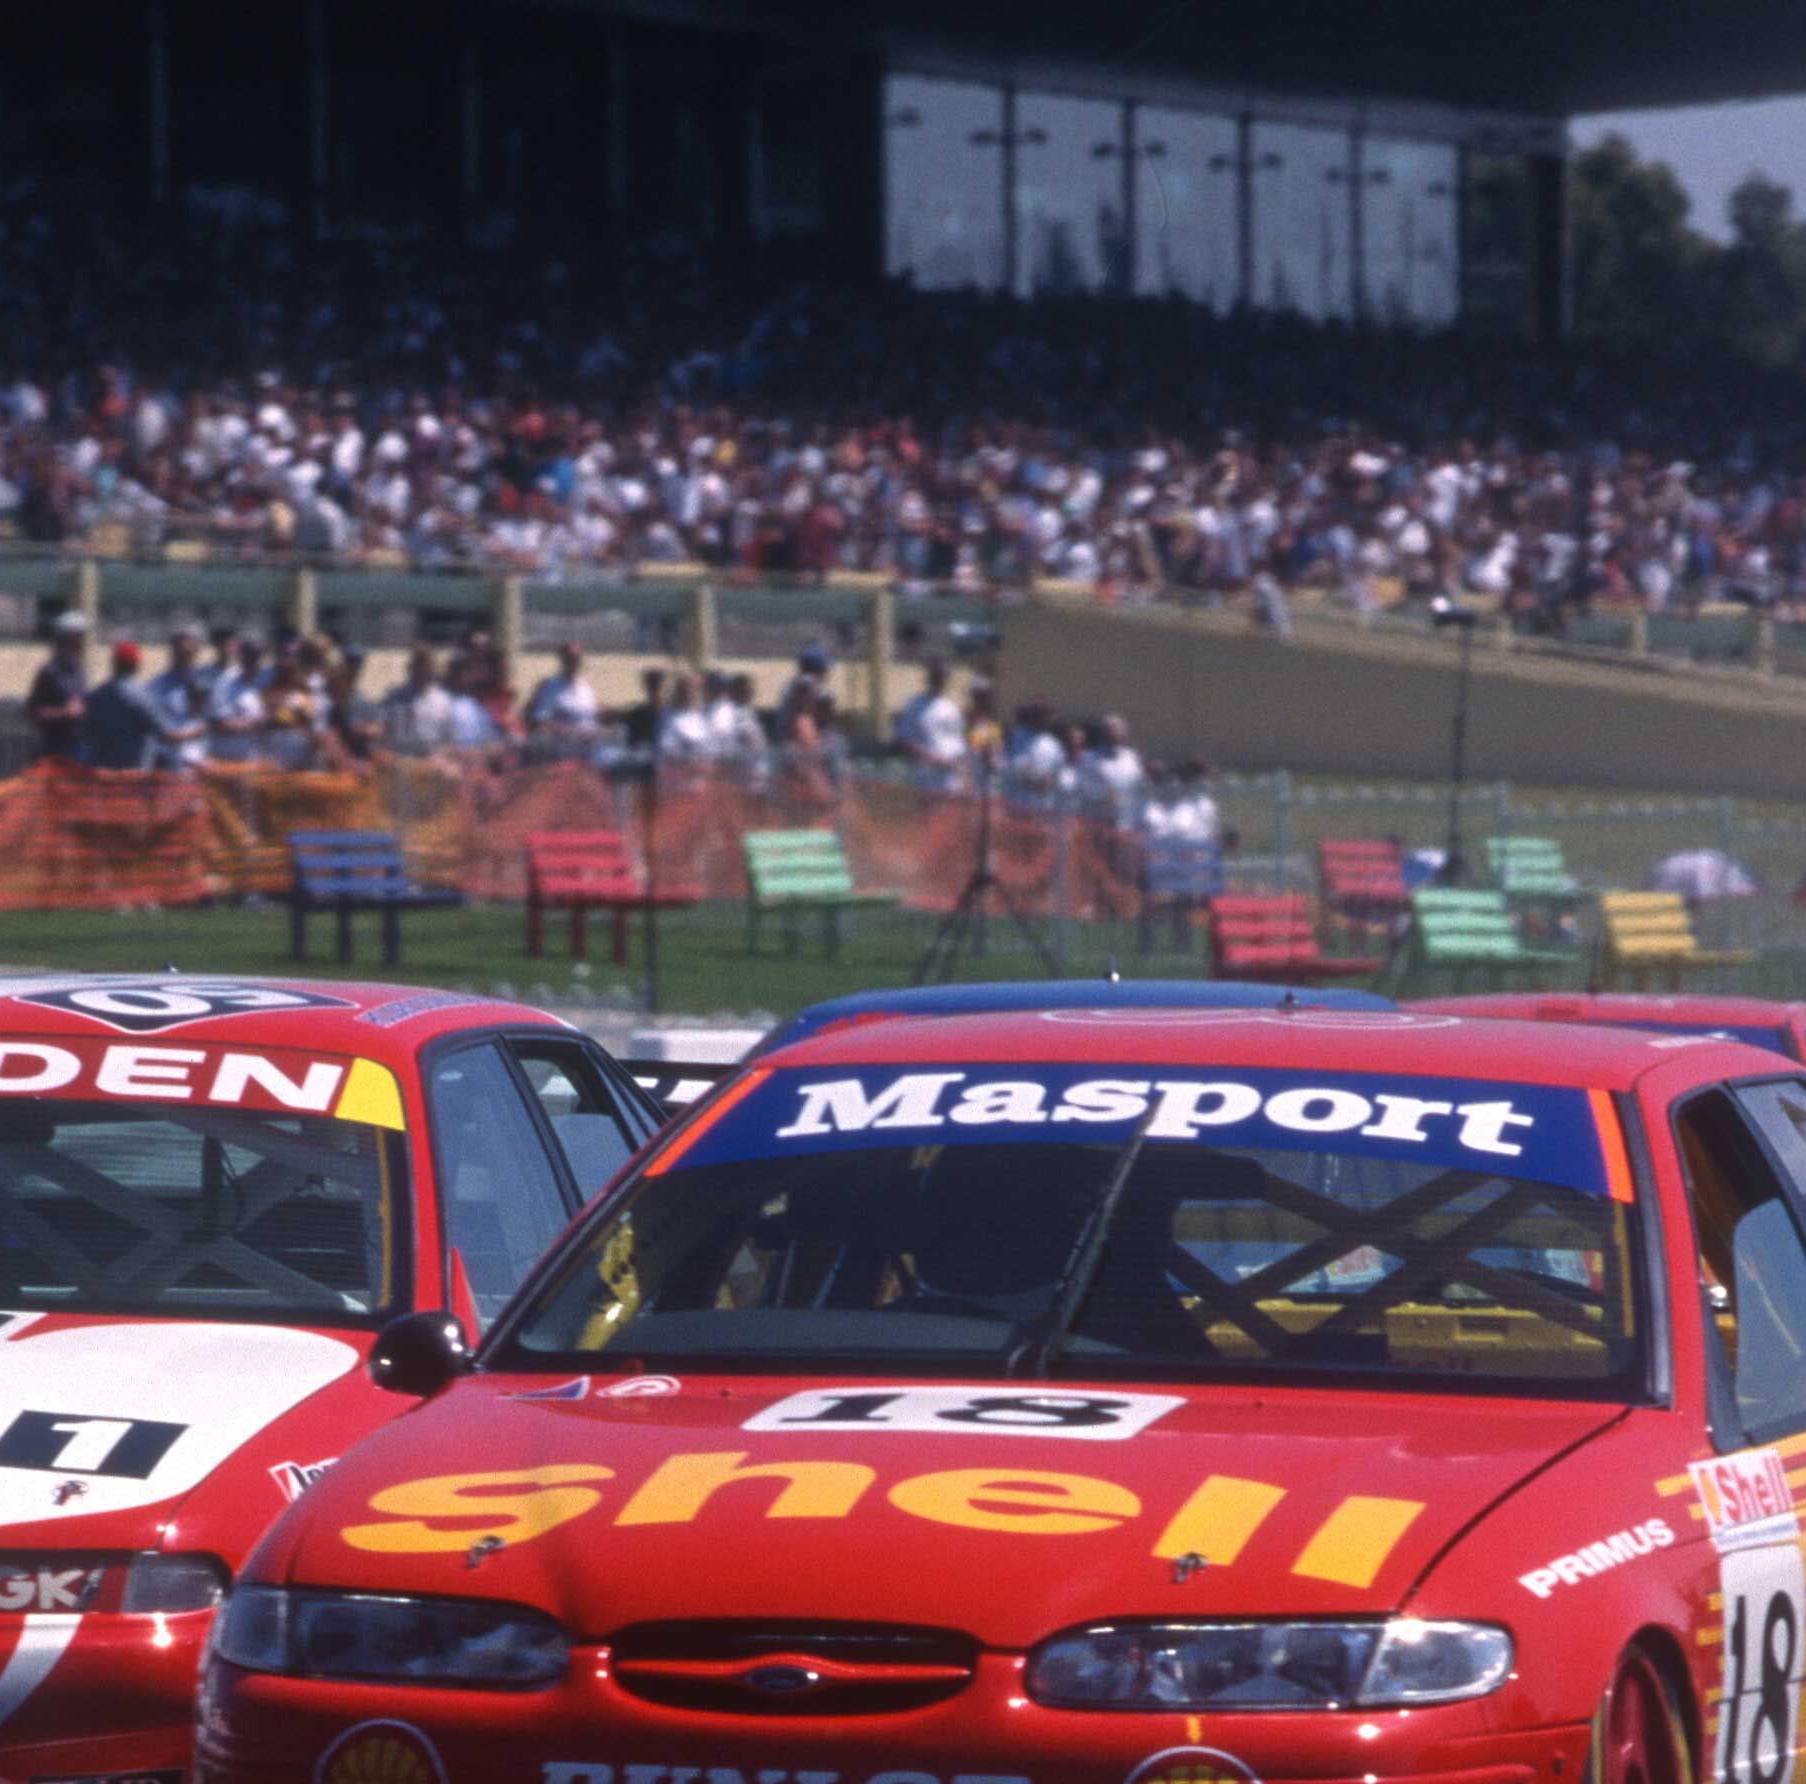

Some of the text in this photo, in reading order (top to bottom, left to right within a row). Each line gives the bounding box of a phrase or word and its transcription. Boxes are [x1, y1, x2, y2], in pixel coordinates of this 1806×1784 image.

[775, 1072, 1533, 1157] Masport
[780, 1392, 1135, 1428] 18
[24, 1419, 106, 1469] 1
[1715, 1457, 1790, 1523] Shell
[1518, 1519, 1674, 1599] PRIMUS
